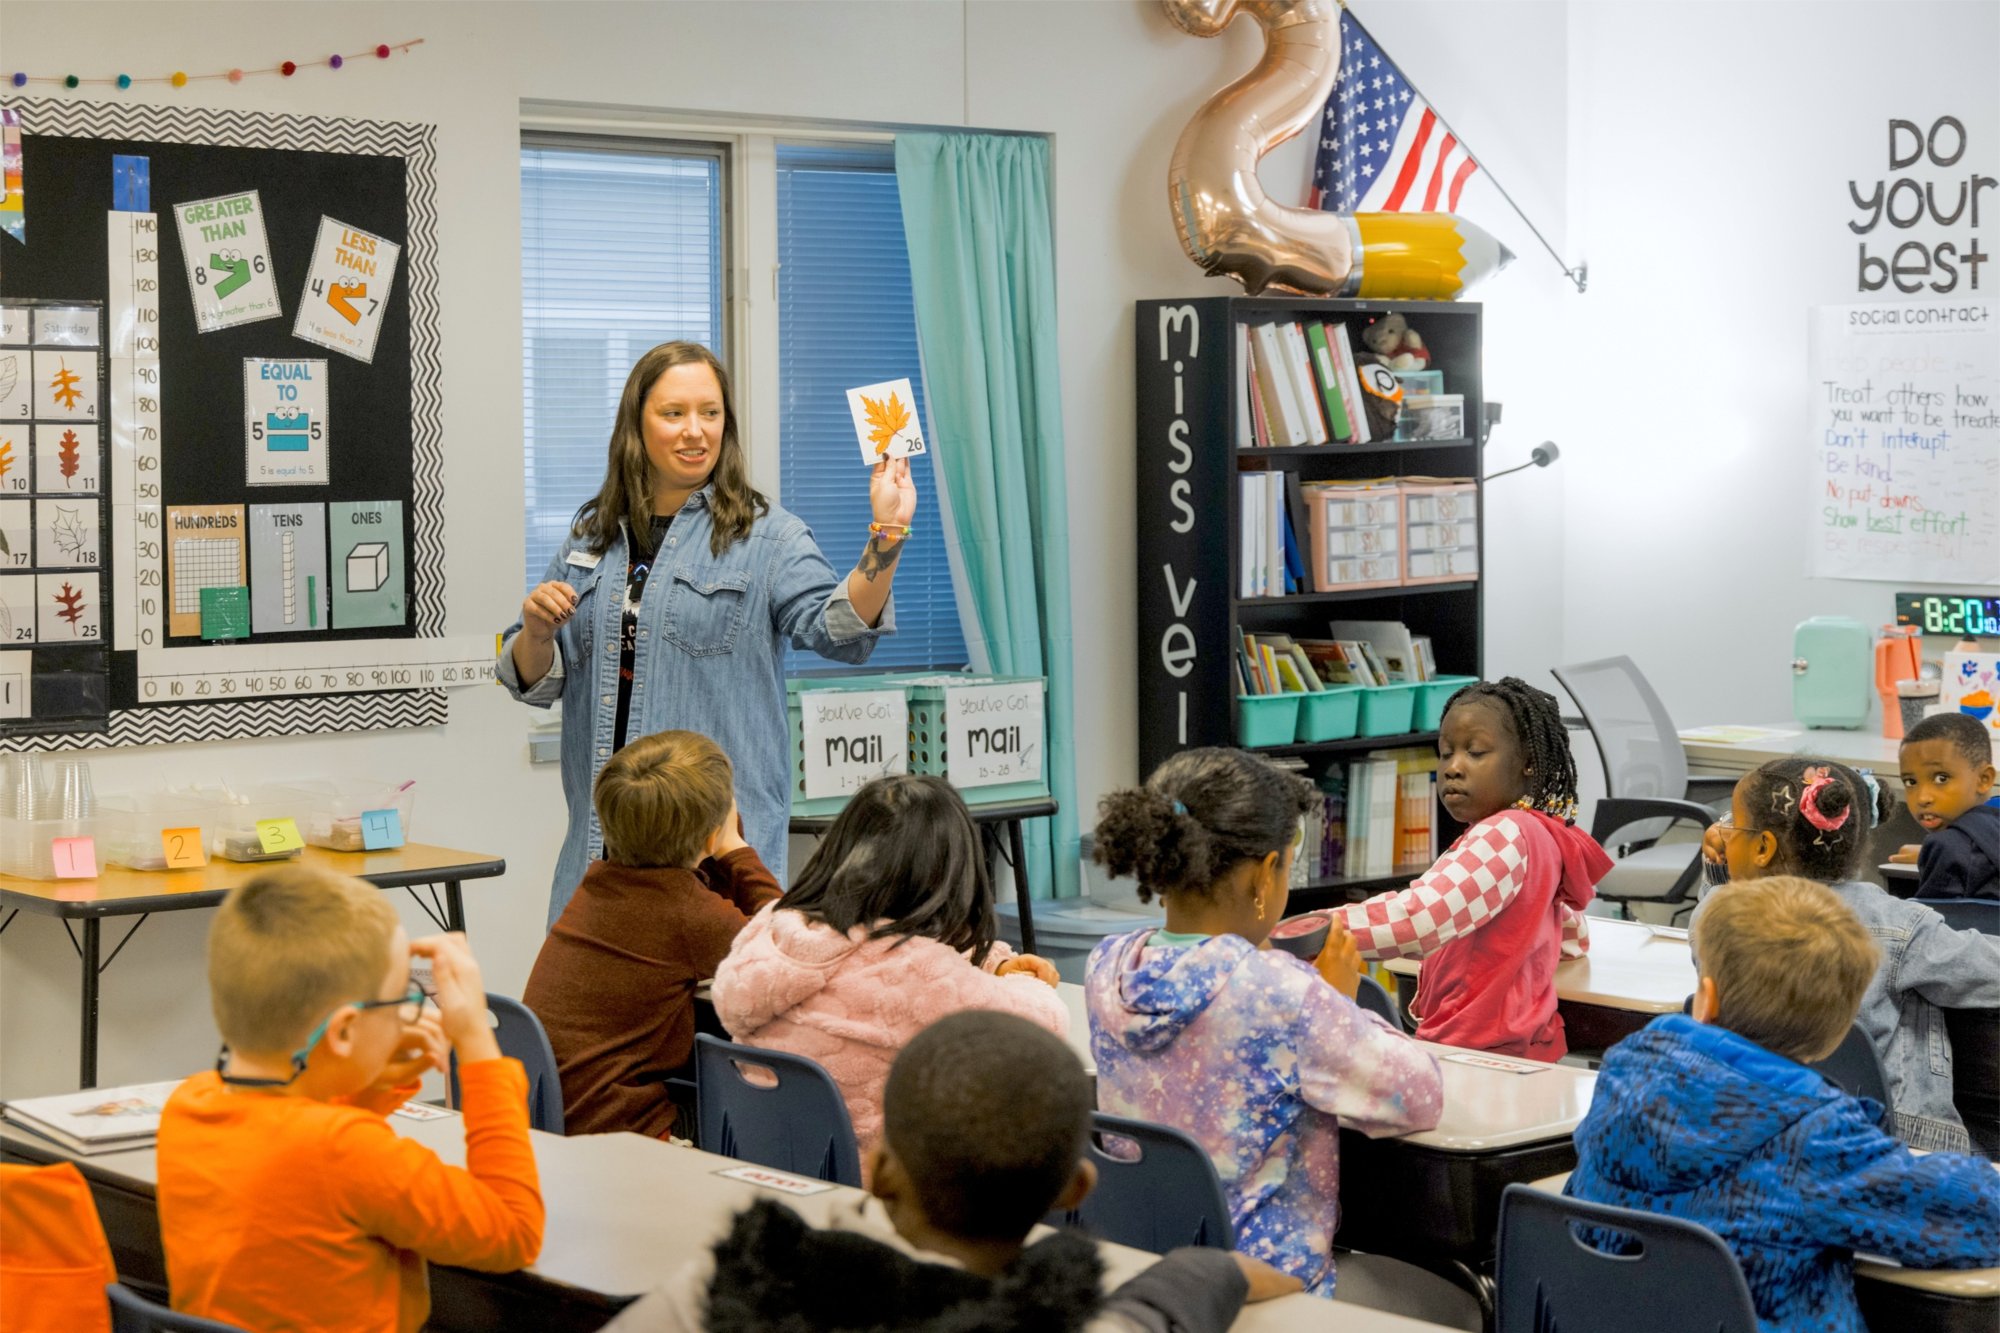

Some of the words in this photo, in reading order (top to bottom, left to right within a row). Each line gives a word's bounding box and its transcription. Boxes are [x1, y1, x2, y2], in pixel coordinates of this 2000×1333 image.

[1889, 115, 1967, 171] DO
[183, 196, 254, 225] GREATER
[1848, 174, 1999, 235] your
[135, 219, 157, 234] 140
[200, 219, 246, 243] THAN
[341, 228, 377, 256] LESS
[136, 248, 158, 263] 130
[335, 247, 377, 277] THAN
[195, 266, 207, 285] 8
[253, 254, 265, 274] 6
[1858, 238, 1989, 294] best
[136, 278, 157, 292] 120
[311, 278, 324, 298] 4
[368, 298, 379, 316] 7
[137, 308, 158, 323] 110
[1850, 309, 1900, 326] social
[1906, 306, 1989, 325] contract
[43, 322, 90, 336] Saturday
[136, 337, 159, 352] 100
[138, 368, 157, 384] 90
[261, 363, 312, 380] EQUAL
[277, 384, 298, 401] TO
[1822, 379, 1874, 405] Treat
[1886, 382, 1945, 407] others
[1956, 384, 1989, 408] how
[20, 404, 28, 416] 3
[87, 405, 95, 416] 4
[139, 397, 158, 413] 80
[1831, 408, 1852, 428] you
[1860, 405, 1896, 423] want
[1903, 405, 1919, 424] to
[1923, 408, 1944, 428] be
[138, 426, 157, 441] 70
[252, 421, 264, 441] 5
[310, 421, 322, 441] 5
[1825, 427, 1869, 449] Don't
[905, 438, 923, 453] 26
[138, 456, 158, 472] 60
[276, 465, 296, 477] equal
[1827, 452, 1849, 473] Be
[12, 479, 26, 490] 10
[83, 478, 95, 489] 11
[138, 483, 159, 498] 50
[1827, 480, 1844, 499] No
[138, 511, 159, 529] 40
[175, 515, 238, 530] HUNDREDS
[272, 513, 303, 527] TENS
[351, 511, 382, 525] ONES
[1823, 506, 1858, 528] Show
[1866, 508, 1903, 533] best
[82, 552, 96, 563] 18
[138, 541, 159, 559] 30
[13, 553, 28, 565] 17
[139, 569, 161, 586] 20
[141, 599, 156, 616] 10
[1924, 596, 1983, 634] 8:20
[16, 628, 32, 640] 24
[82, 625, 97, 637] 25
[170, 681, 184, 696] 10
[194, 679, 212, 695] 20
[219, 678, 237, 694] 30
[245, 678, 264, 693] 40
[269, 677, 286, 691] 50
[294, 675, 312, 690] 60
[320, 674, 337, 688] 70
[346, 672, 364, 687] 80
[371, 671, 388, 685] 90
[391, 669, 411, 684] 100
[420, 669, 434, 683] 110
[442, 667, 457, 682] 120
[461, 667, 475, 680] 130
[825, 734, 882, 767] mail
[968, 726, 1021, 758] mail
[269, 826, 286, 845] 3
[370, 817, 390, 840] 4
[169, 835, 191, 860] 2
